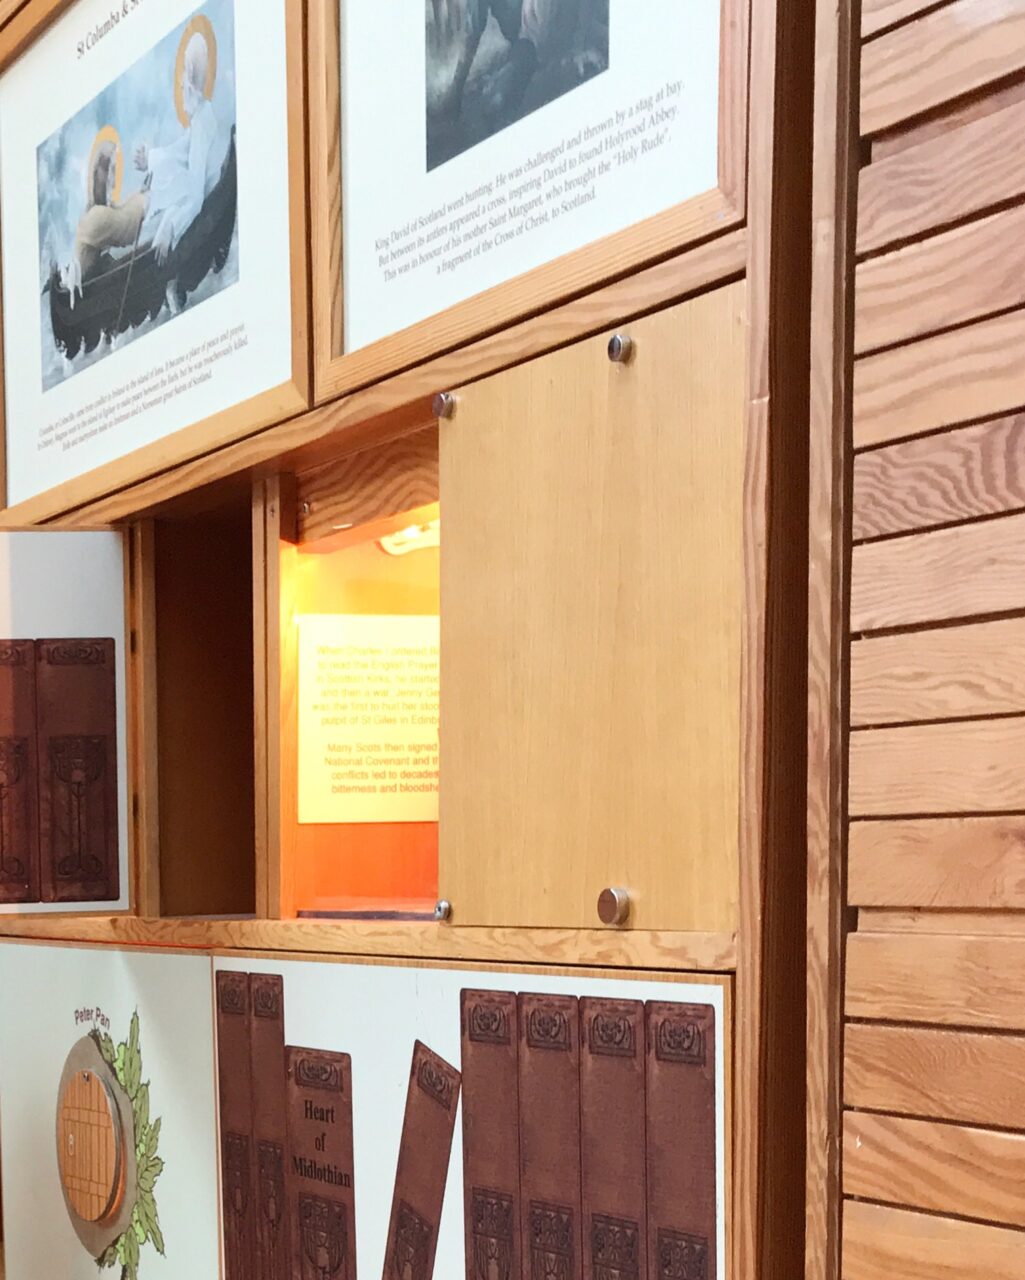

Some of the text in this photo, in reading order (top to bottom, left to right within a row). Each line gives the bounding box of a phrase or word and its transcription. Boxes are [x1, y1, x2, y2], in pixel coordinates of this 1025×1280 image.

[86, 11, 120, 50] Columba
[391, 223, 409, 243] David
[411, 219, 417, 232] of
[418, 204, 446, 229] Scotland
[447, 196, 464, 212] went
[496, 174, 506, 188] He
[508, 166, 522, 180] was
[524, 140, 564, 173] challenged
[567, 131, 581, 150] and
[584, 118, 613, 141] thrown
[616, 111, 625, 125] by
[628, 107, 633, 118] a
[636, 97, 653, 113] stag
[655, 88, 663, 103] at
[390, 242, 416, 261] between
[417, 237, 425, 248] its
[426, 225, 448, 243] antlers
[449, 205, 480, 233] appeared
[482, 205, 486, 214] a
[509, 176, 541, 200] inspiring
[544, 159, 567, 182] David
[569, 159, 576, 170] to
[579, 140, 602, 164] found
[605, 118, 645, 151] Holyrood
[384, 269, 397, 282] This
[398, 262, 410, 274] was
[411, 259, 418, 268] in
[419, 245, 442, 264] honour
[443, 238, 450, 252] of
[452, 235, 462, 249] his
[463, 223, 487, 242] mother
[489, 213, 507, 230] Saint
[546, 185, 563, 200] who
[564, 168, 596, 192] brought
[598, 161, 611, 175] the
[437, 266, 440, 274] a
[442, 248, 472, 272] fragment
[473, 244, 480, 256] of
[482, 240, 493, 252] the
[494, 229, 515, 246] Cross
[516, 221, 523, 235] of
[552, 208, 559, 219] to
[324, 756, 429, 766] National Covenant and
[327, 743, 438, 755] Many Scots then signed
[331, 770, 369, 780] conflicts
[372, 770, 386, 780] led
[388, 770, 397, 780] to
[331, 783, 397, 793] bitterness and
[74, 1006, 110, 1030] Peter Pan
[304, 1100, 335, 1124] Heart
[314, 1132, 326, 1152] of
[293, 1156, 351, 1188] Midlothian
